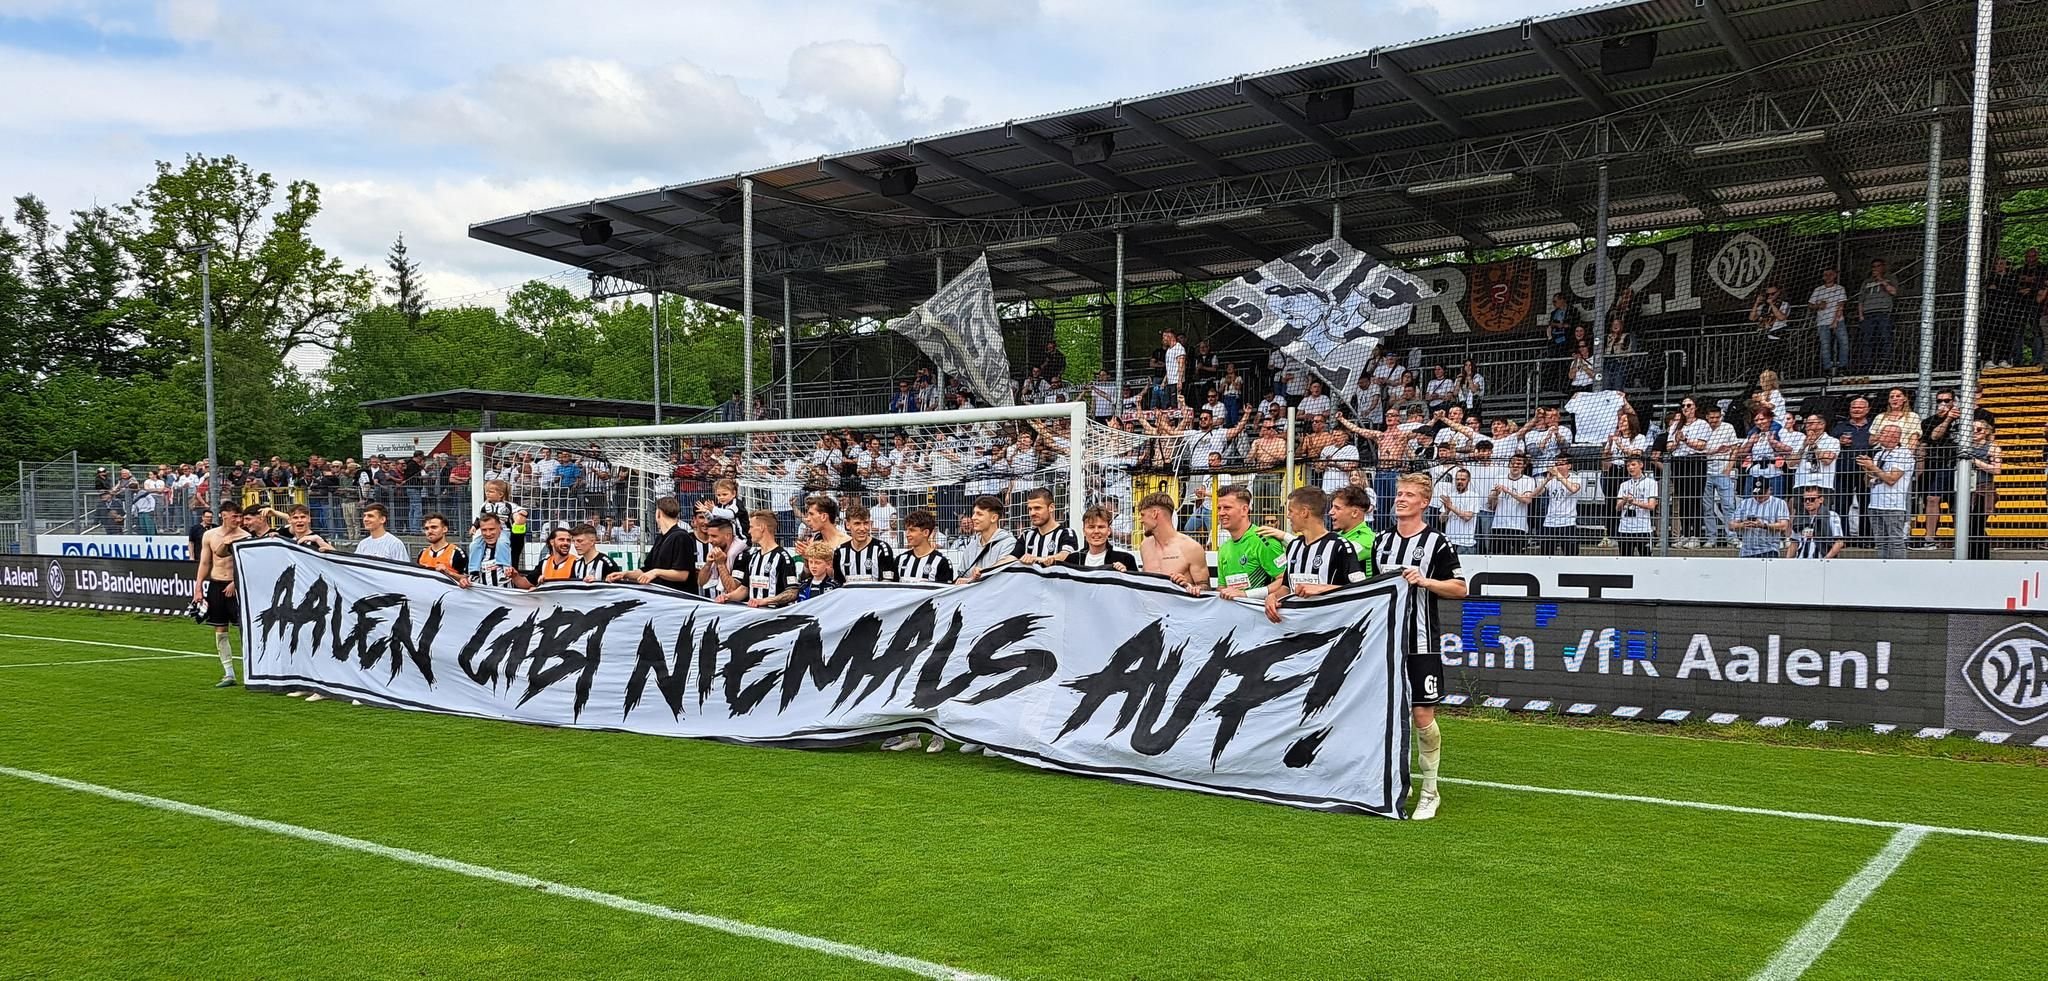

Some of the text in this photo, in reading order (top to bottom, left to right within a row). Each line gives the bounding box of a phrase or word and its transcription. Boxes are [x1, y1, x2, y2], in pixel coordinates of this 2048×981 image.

[1536, 239, 1701, 326] 1921
[4, 565, 38, 587] Aalen!
[75, 569, 210, 597] LED-Bandenwerbug
[254, 564, 1374, 773] AALEN GIBT NIEMALS AUF!
[1676, 633, 1892, 691] Aalen!
